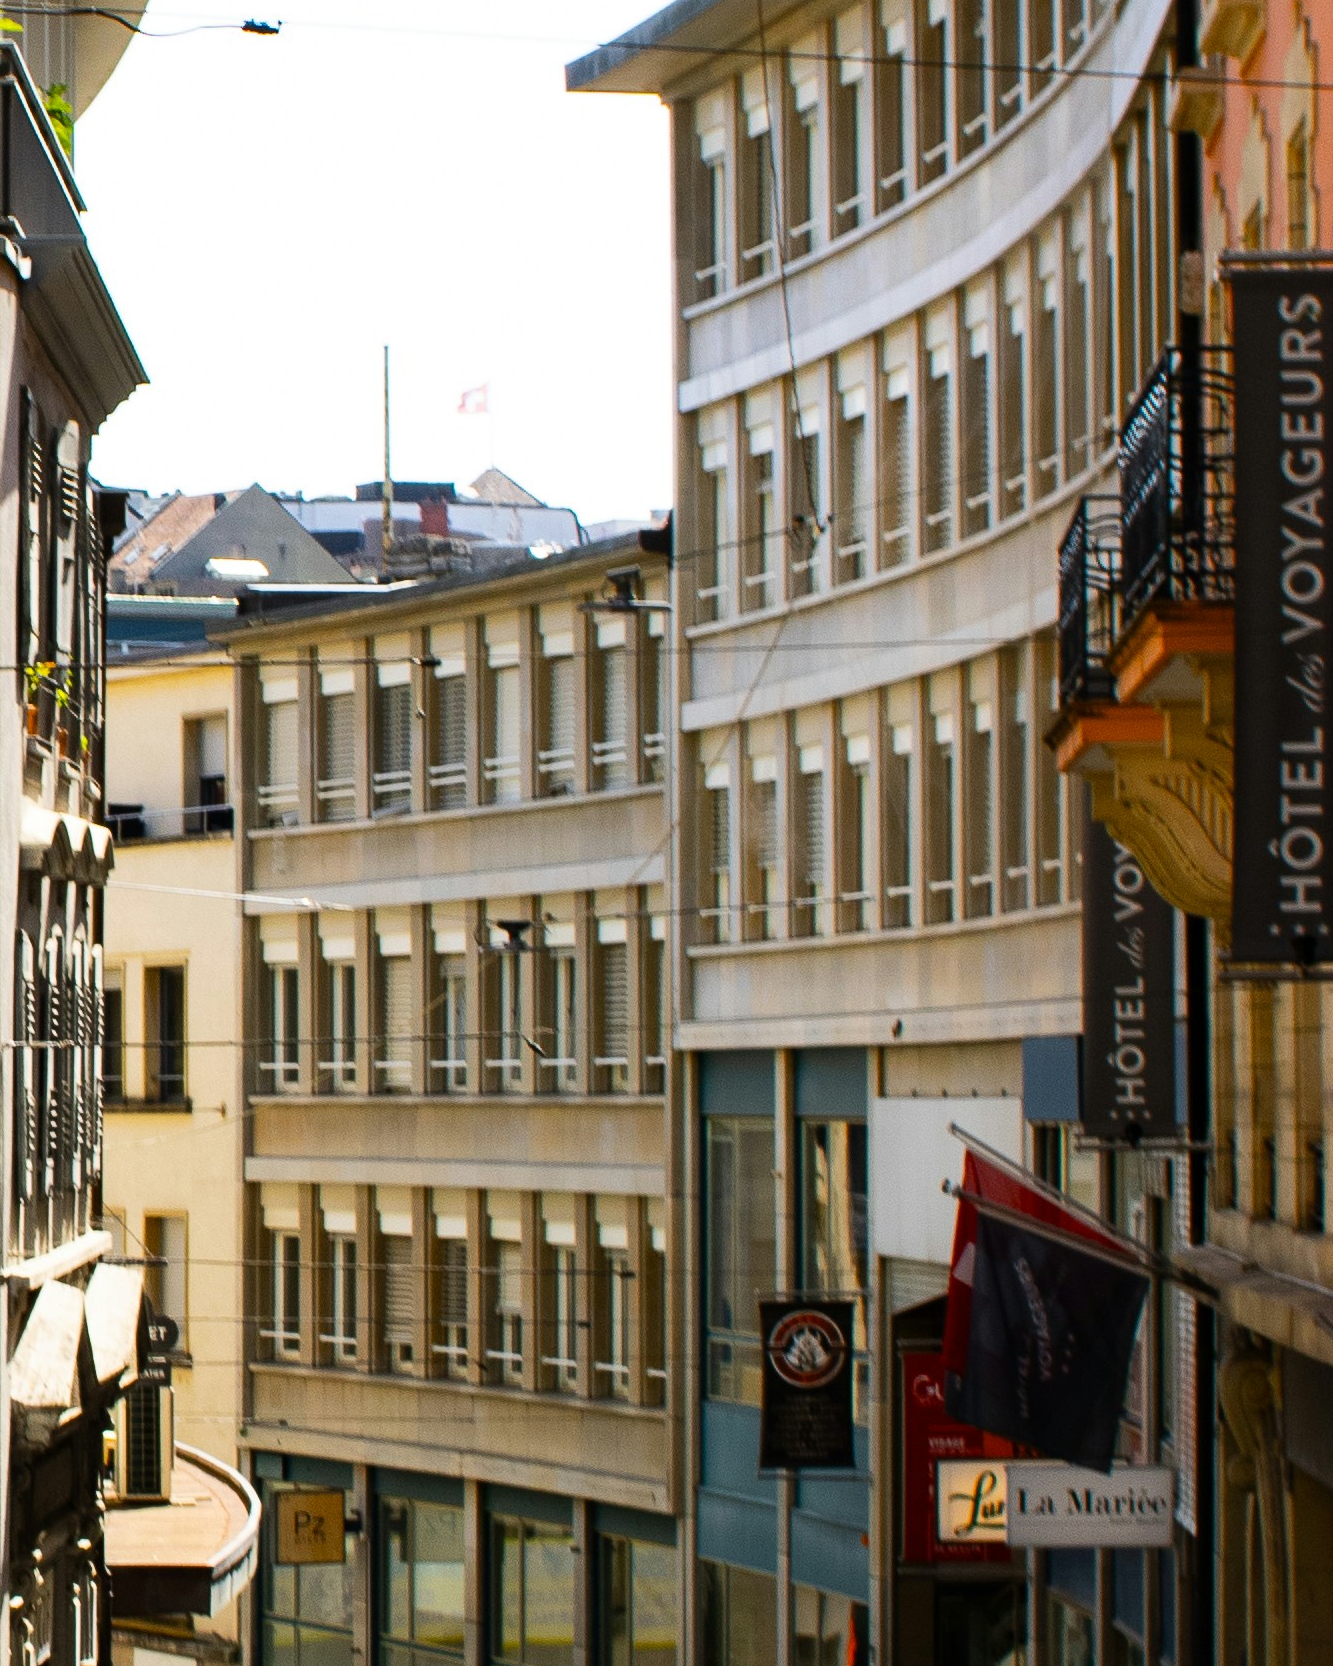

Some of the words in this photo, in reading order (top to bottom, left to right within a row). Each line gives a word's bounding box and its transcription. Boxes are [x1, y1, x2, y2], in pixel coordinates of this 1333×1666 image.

[1279, 292, 1323, 645] VOYAGEURS
[1288, 652, 1327, 712] des
[1268, 725, 1324, 916] HÔTEL
[1106, 974, 1146, 1105] HÔTEL
[1016, 1487, 1056, 1514] La
[1066, 1484, 1168, 1517] Mariée
